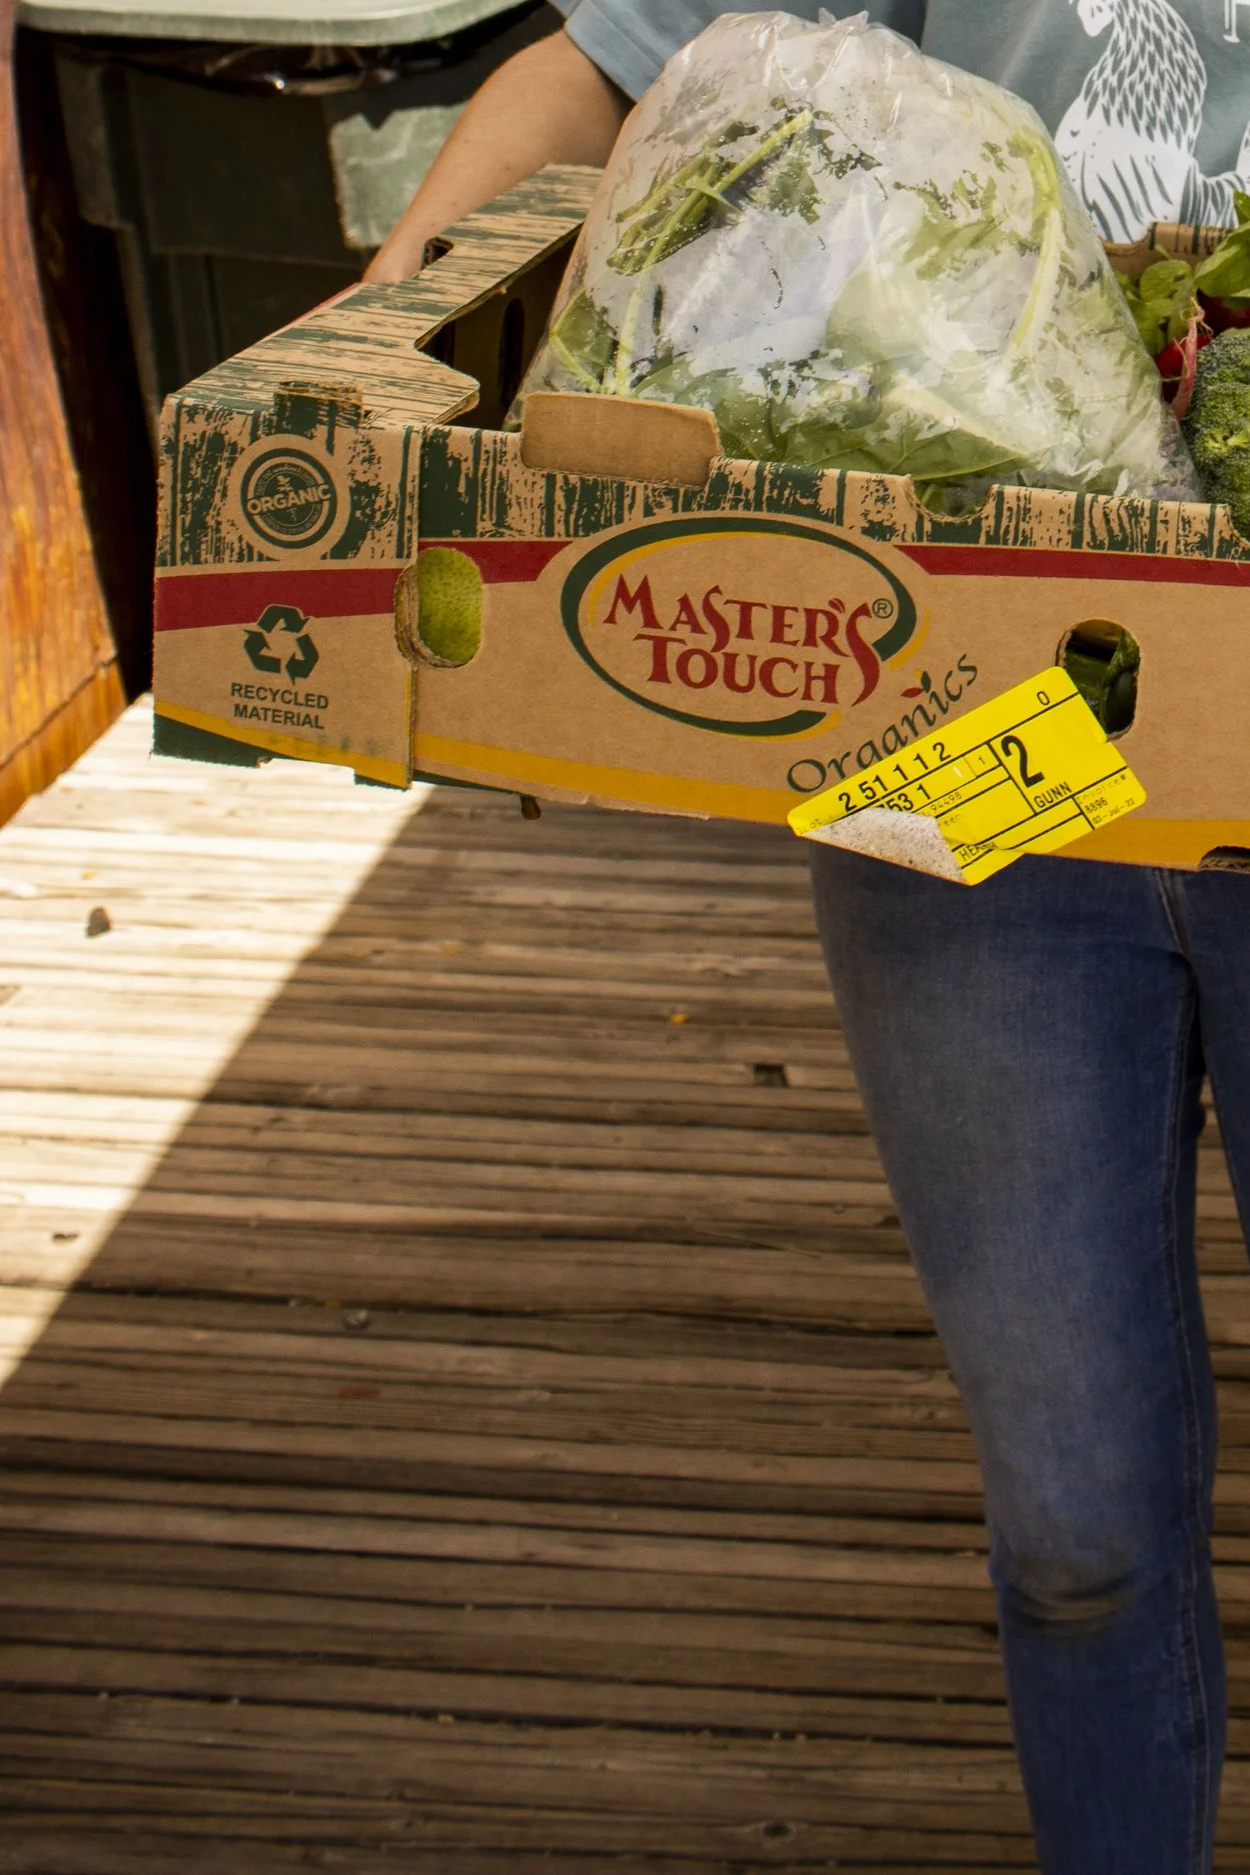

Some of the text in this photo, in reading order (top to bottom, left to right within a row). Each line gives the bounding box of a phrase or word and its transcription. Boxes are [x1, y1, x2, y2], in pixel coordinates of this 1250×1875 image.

[247, 484, 331, 515] ORGANIC
[602, 573, 880, 707] MASTER'S
[633, 633, 841, 704] TOUCH
[230, 682, 329, 711] RECYCLED
[233, 703, 325, 730] MATERIAL
[786, 651, 979, 793] Organics
[1001, 735, 1045, 788] 2
[875, 793, 914, 812] 53
[1033, 781, 1073, 809] GUNN
